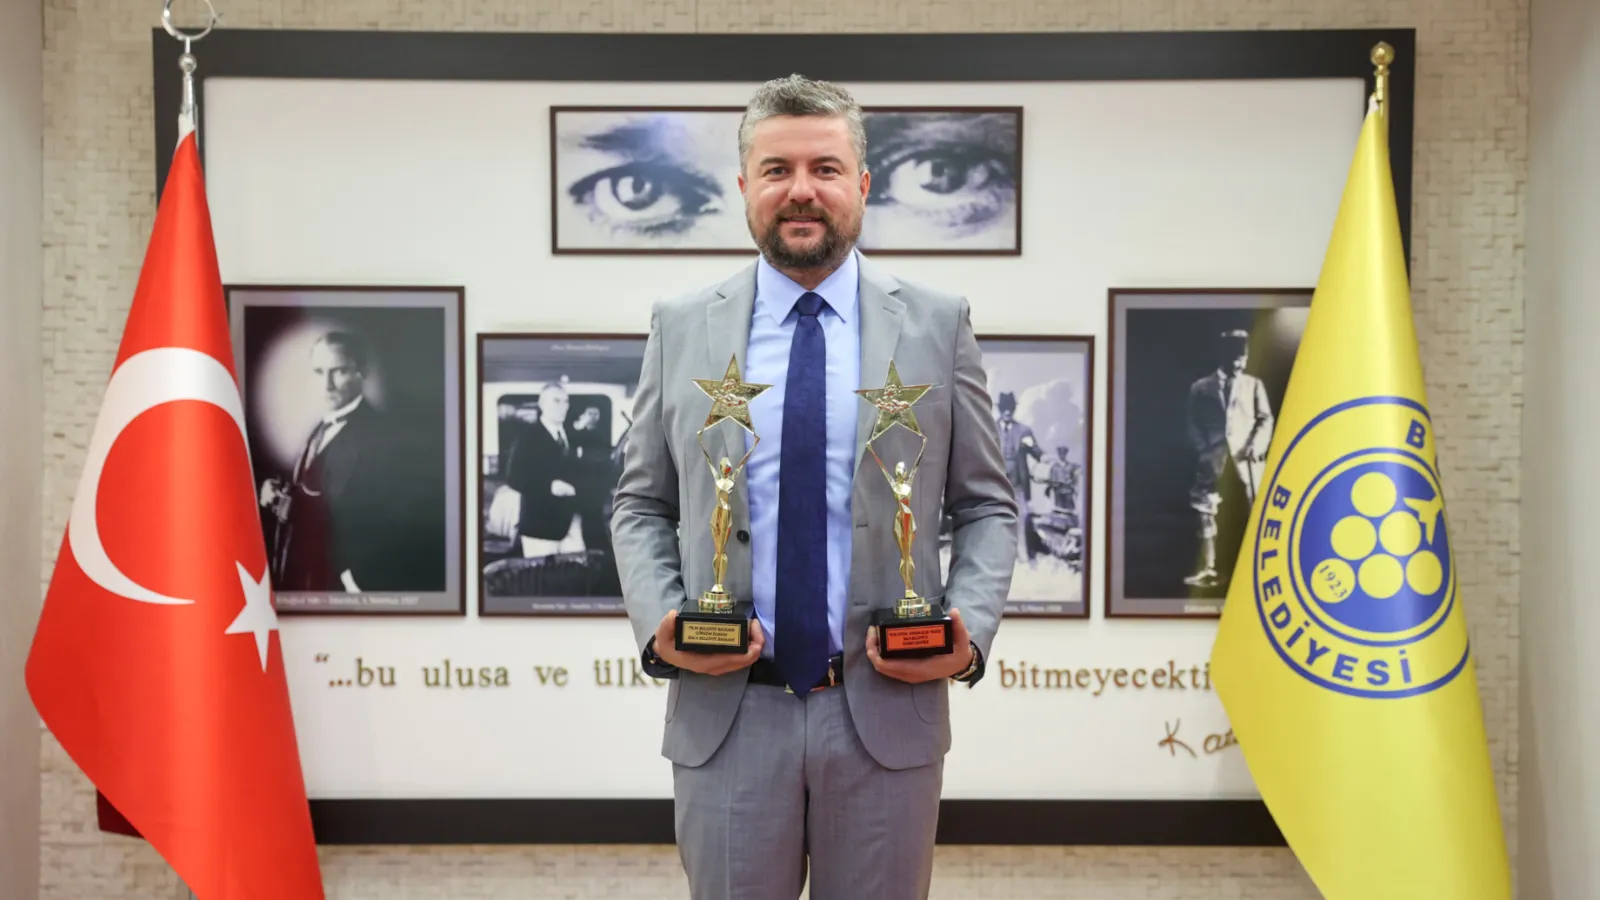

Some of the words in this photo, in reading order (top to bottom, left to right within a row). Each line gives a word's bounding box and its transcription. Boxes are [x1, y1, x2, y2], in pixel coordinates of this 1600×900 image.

[1261, 484, 1412, 686] BELEDİYESİ
[1319, 564, 1348, 598] 1923
[422, 658, 511, 688] ulusa
[534, 665, 569, 687] ve
[998, 659, 1211, 697] bitmeyecekti
